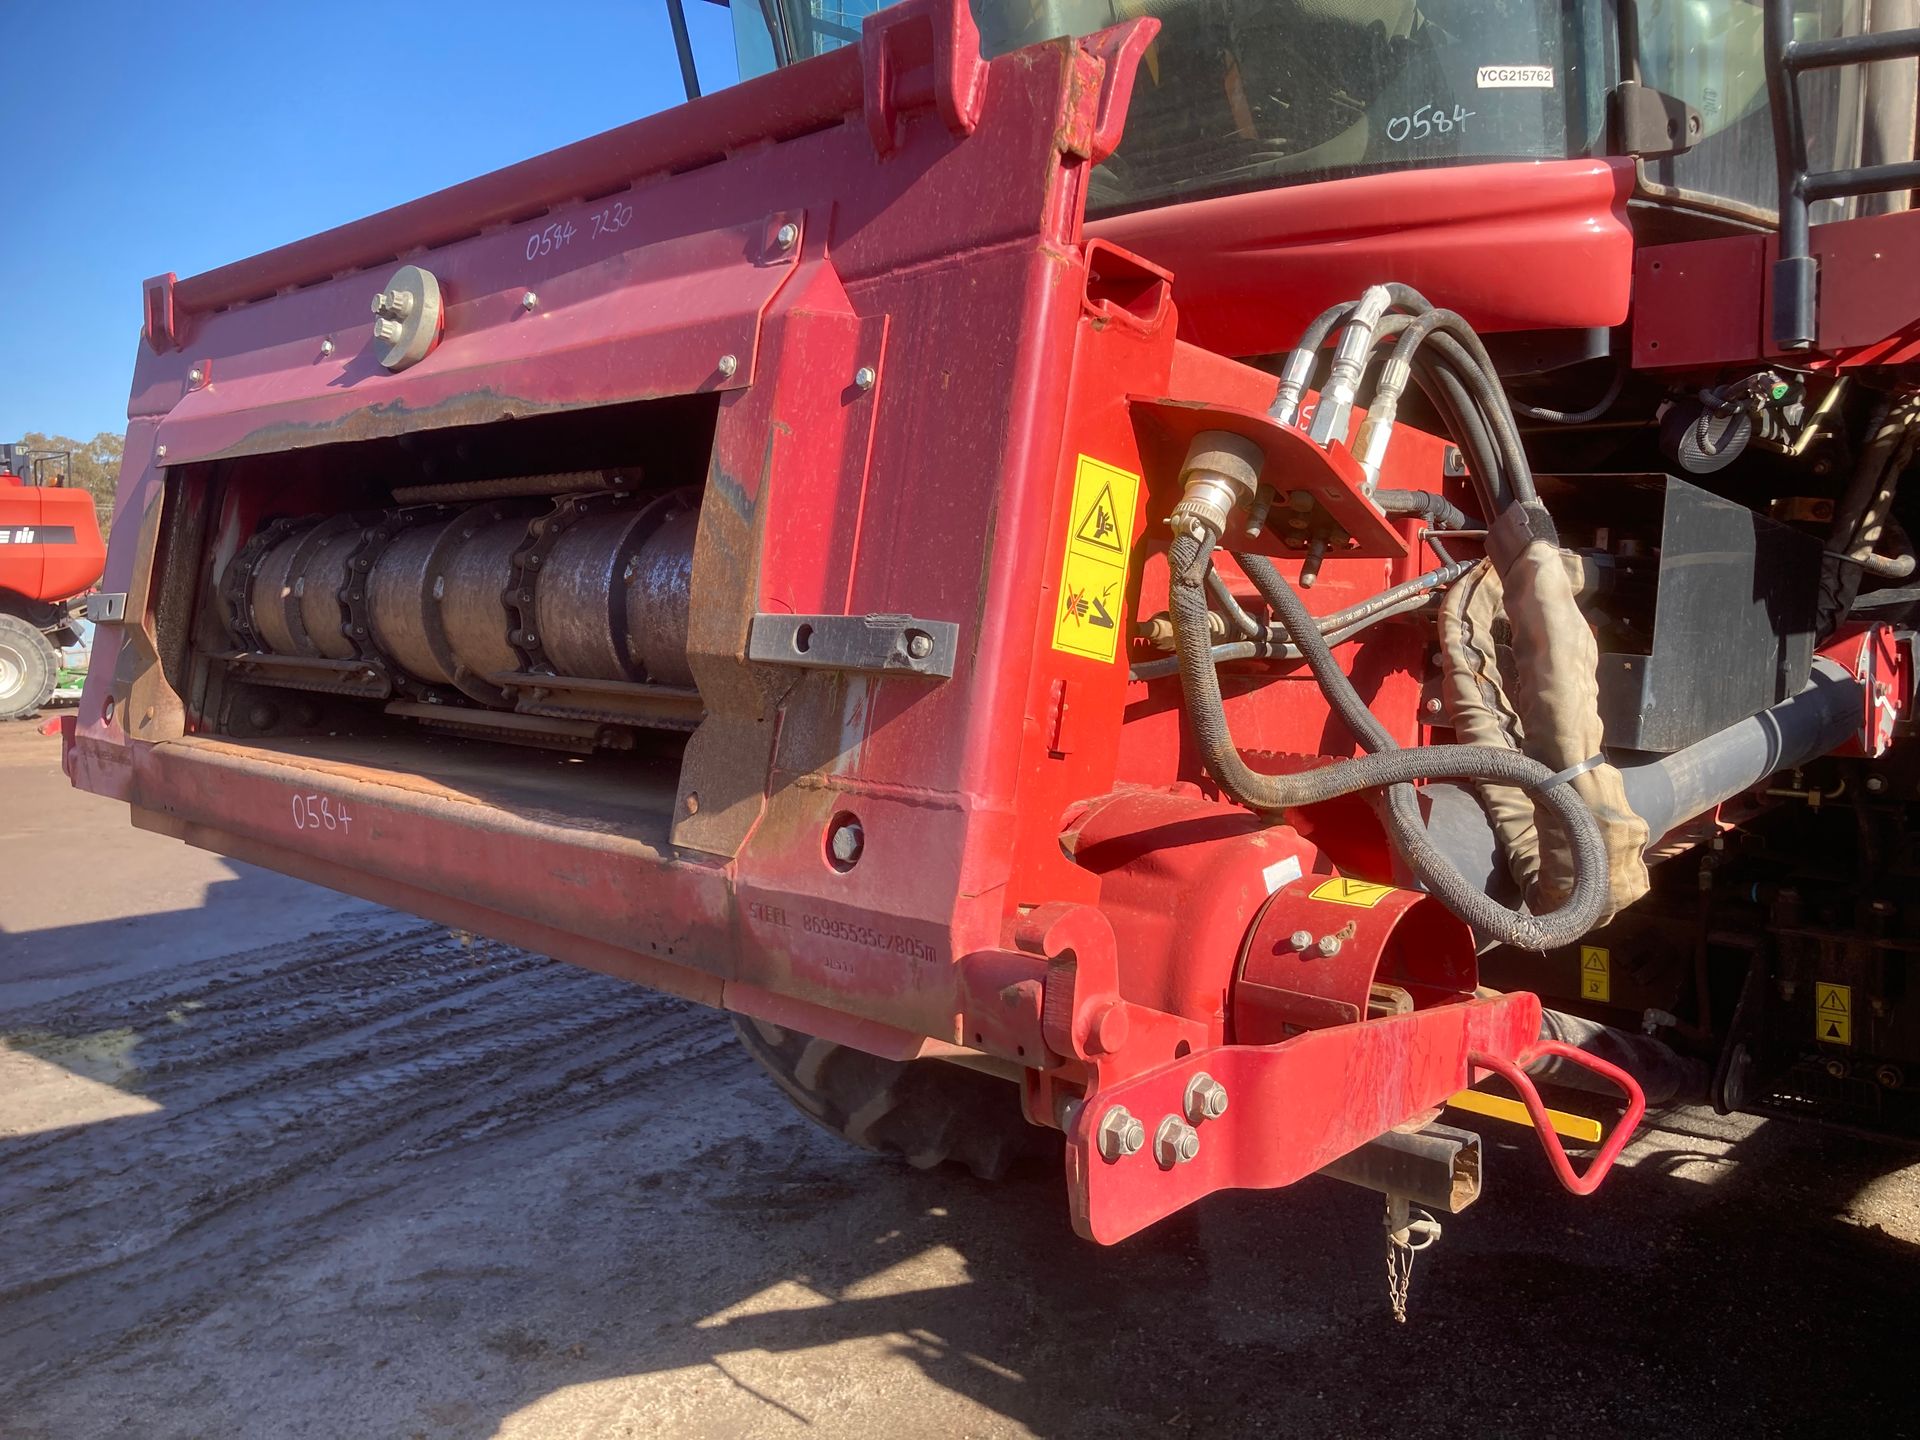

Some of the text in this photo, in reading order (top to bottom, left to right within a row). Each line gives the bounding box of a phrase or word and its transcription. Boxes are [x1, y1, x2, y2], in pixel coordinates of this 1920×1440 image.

[1479, 69, 1551, 82] YCG215762
[1386, 104, 1476, 141] 0584
[526, 202, 633, 260] 0584 7230
[292, 794, 353, 835] 0584
[750, 902, 792, 928] STEEL
